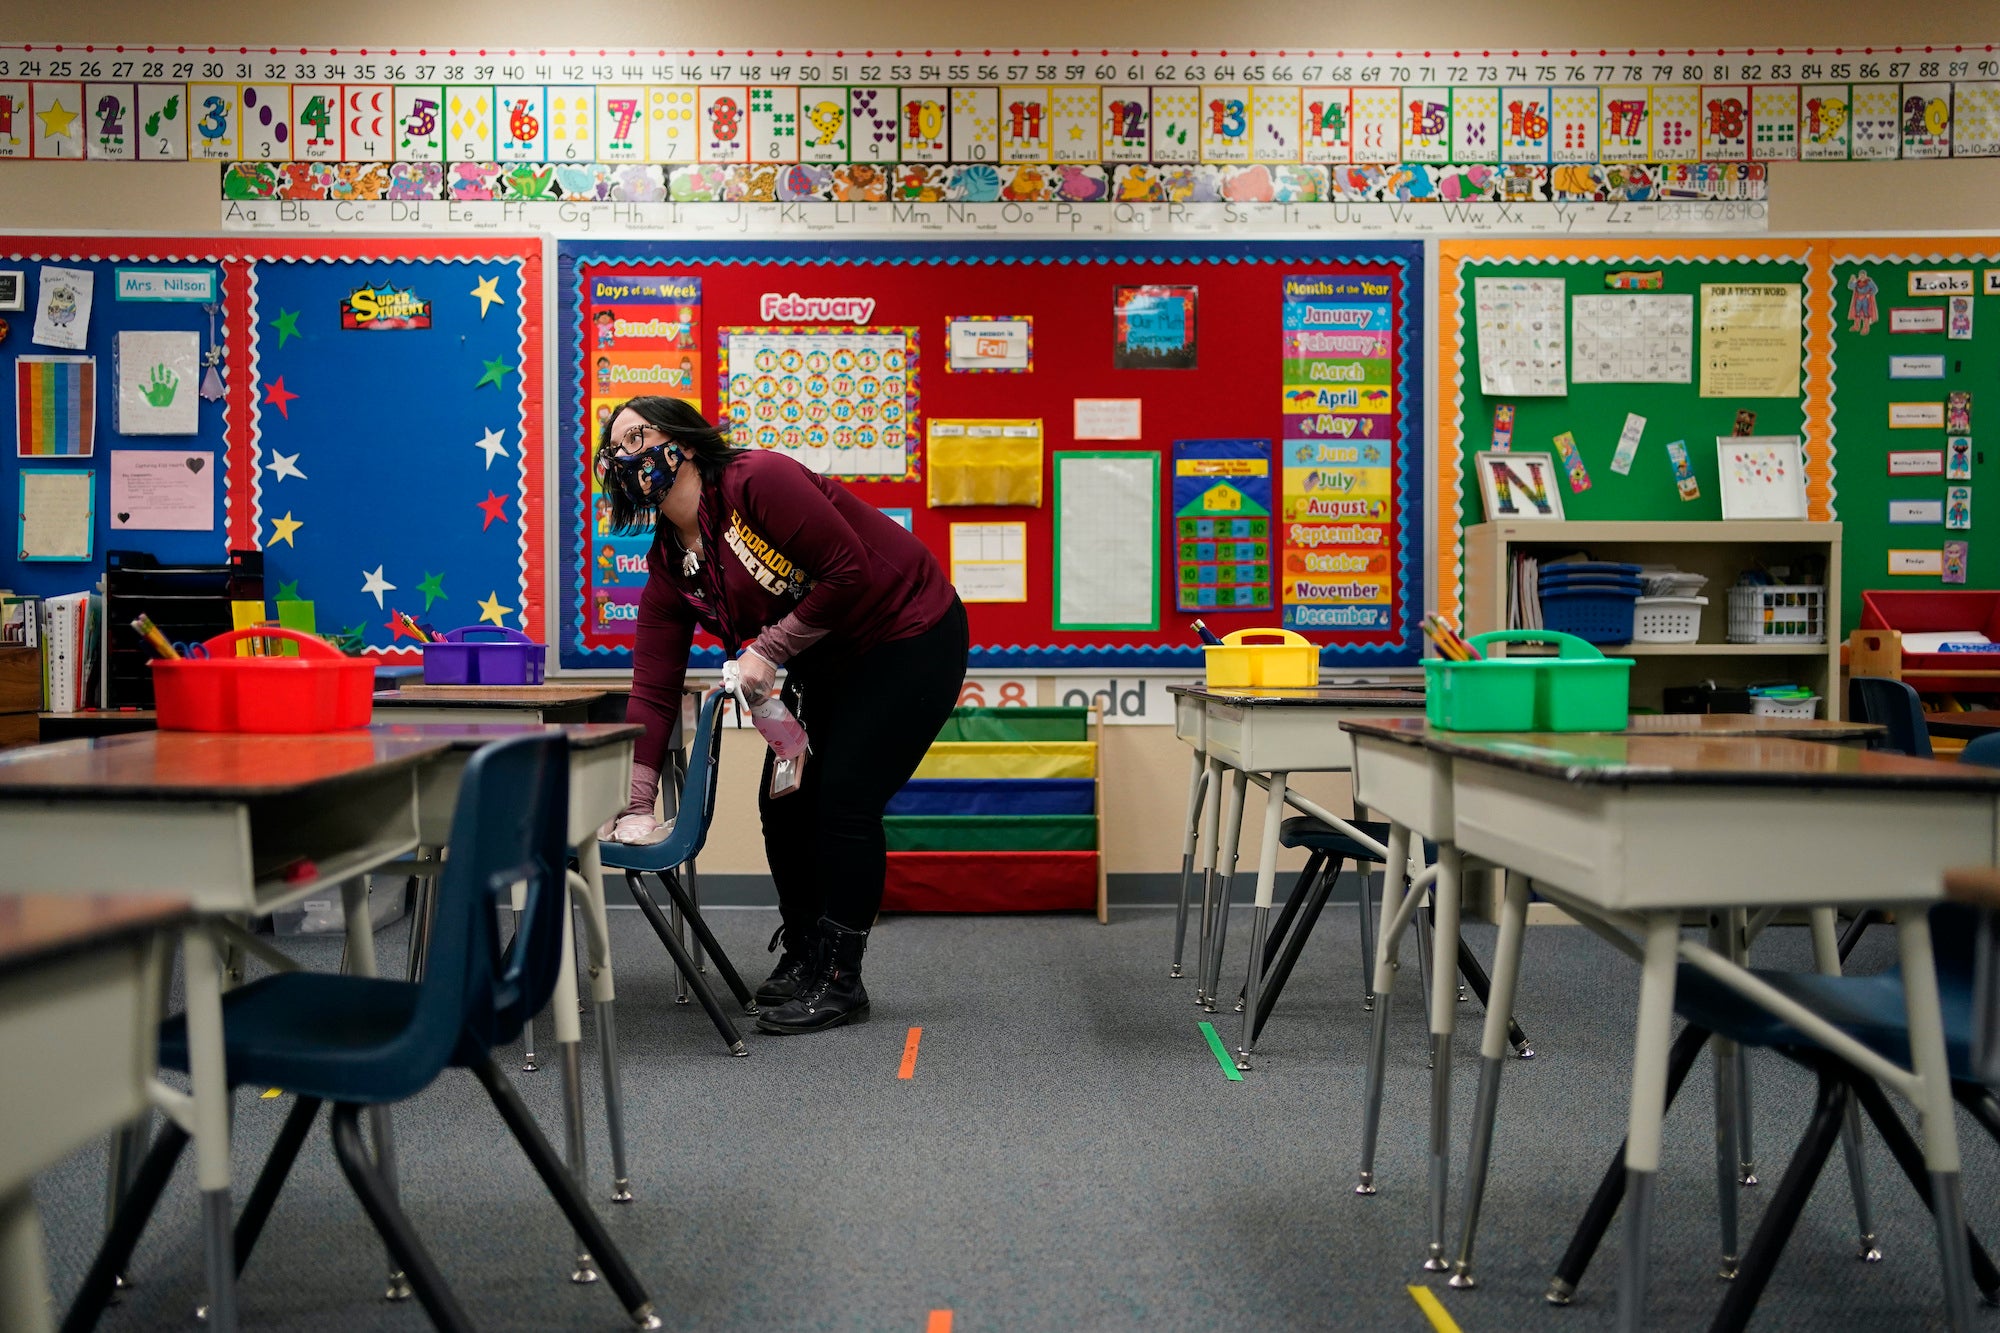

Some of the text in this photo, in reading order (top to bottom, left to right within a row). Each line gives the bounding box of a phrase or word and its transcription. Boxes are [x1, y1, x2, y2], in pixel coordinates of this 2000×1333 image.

[18, 60, 2000, 83] 24 25 26 27 28 29 40 41 42 43 44 51 52 53 54 55 62 63 64 65 74 75 76 77 87 88 89 90
[510, 99, 539, 141] 6
[104, 143, 123, 155] two
[159, 138, 169, 154] 2
[203, 147, 229, 158] three
[261, 142, 271, 158] 3
[306, 147, 326, 158] four
[464, 143, 475, 160] 5
[869, 143, 880, 160] 9
[967, 144, 986, 160] 10
[1805, 148, 1844, 158] nineteen
[125, 278, 207, 292] Mrs. Nilson
[596, 283, 697, 300] Days of the Week
[1286, 281, 1390, 296] Months of the Year
[1711, 287, 1727, 297] FOR
[1727, 287, 1734, 296] A
[1735, 287, 1762, 297] TRICKY
[1915, 277, 1969, 291] Looks
[351, 288, 411, 321] SUPER
[763, 295, 873, 323] February
[1304, 306, 1372, 328] January
[614, 319, 680, 341] Sunday
[978, 340, 1007, 356] Fall
[1298, 333, 1375, 356] February
[764, 356, 898, 368] 1 2 3 4 5 6
[612, 366, 682, 386] Monday
[1310, 362, 1364, 381] March
[739, 381, 900, 393] 7 8 9 10 11 12 13
[1317, 389, 1358, 409] April
[733, 405, 899, 417] 14 15 16 17 18 19 20
[1316, 414, 1357, 438] May
[736, 431, 900, 443] 21 22 23 24 25 26 27
[1317, 445, 1358, 462] June
[1319, 472, 1356, 491] July
[1489, 461, 1553, 514] N
[1217, 489, 1228, 498] 10
[1208, 499, 1213, 508] 2
[1308, 499, 1367, 519] August
[1219, 523, 1226, 533] 2
[1291, 524, 1381, 547] September
[730, 508, 793, 577] ELDORADO
[723, 525, 788, 596] SUNDEVILS
[1305, 552, 1369, 572] October
[1297, 581, 1378, 598] November
[1296, 606, 1378, 625] December
[1062, 680, 1146, 717] odd
